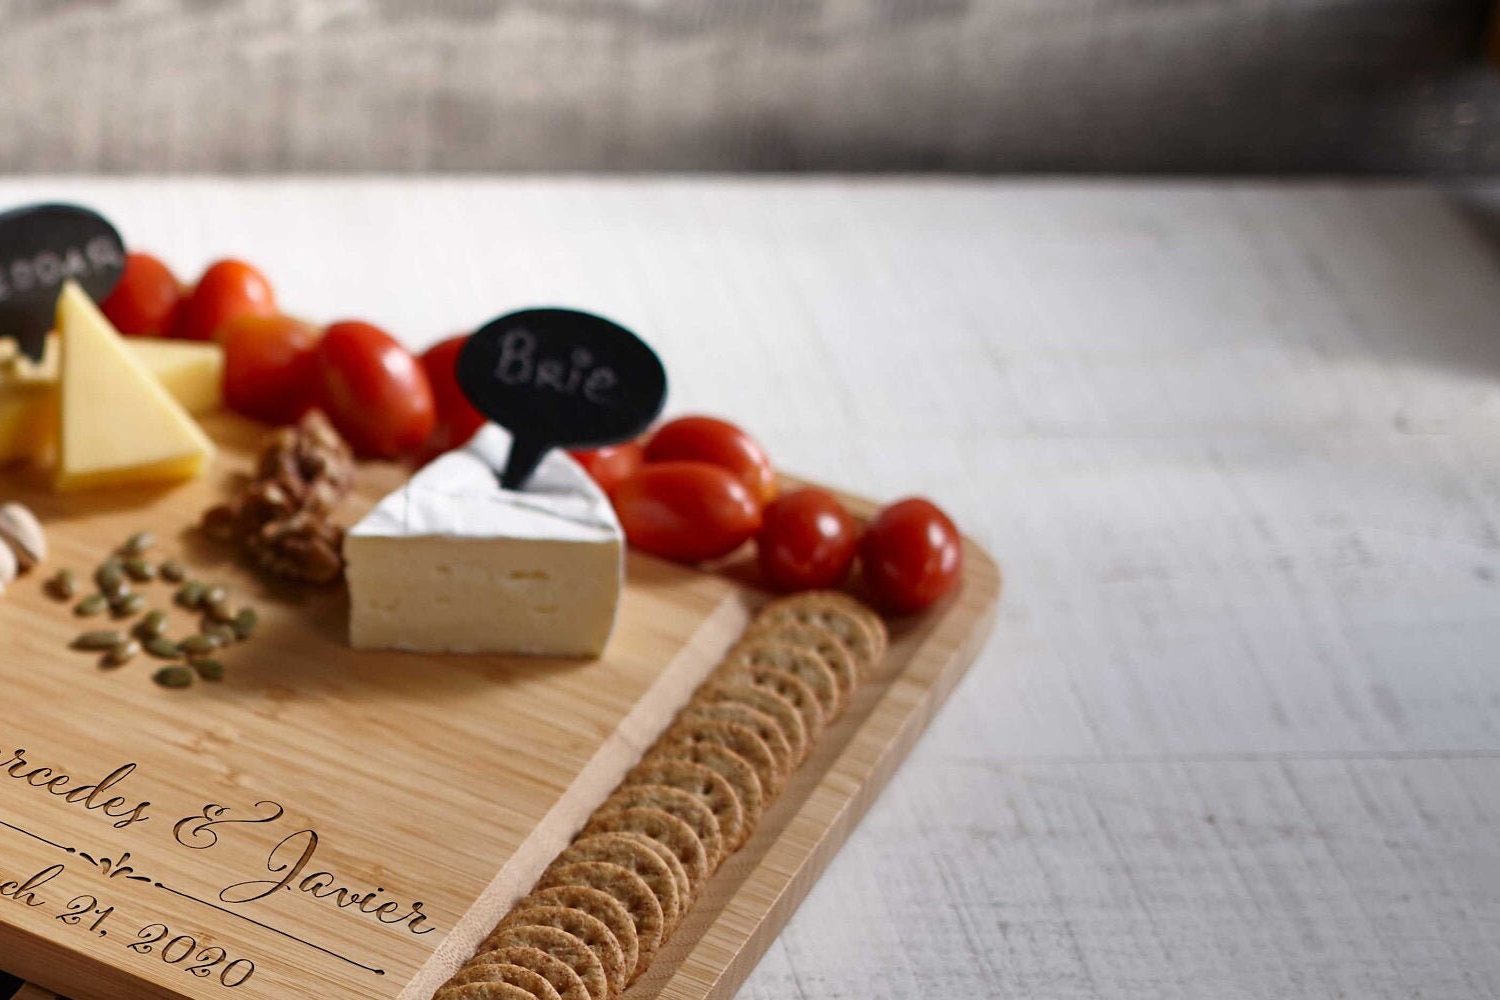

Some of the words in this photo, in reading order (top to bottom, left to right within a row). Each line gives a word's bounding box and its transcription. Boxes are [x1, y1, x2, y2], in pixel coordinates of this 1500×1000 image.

[172, 799, 285, 850] &
[218, 829, 437, 936] Javier
[55, 894, 115, 939] 21,
[126, 922, 256, 988] 2020
